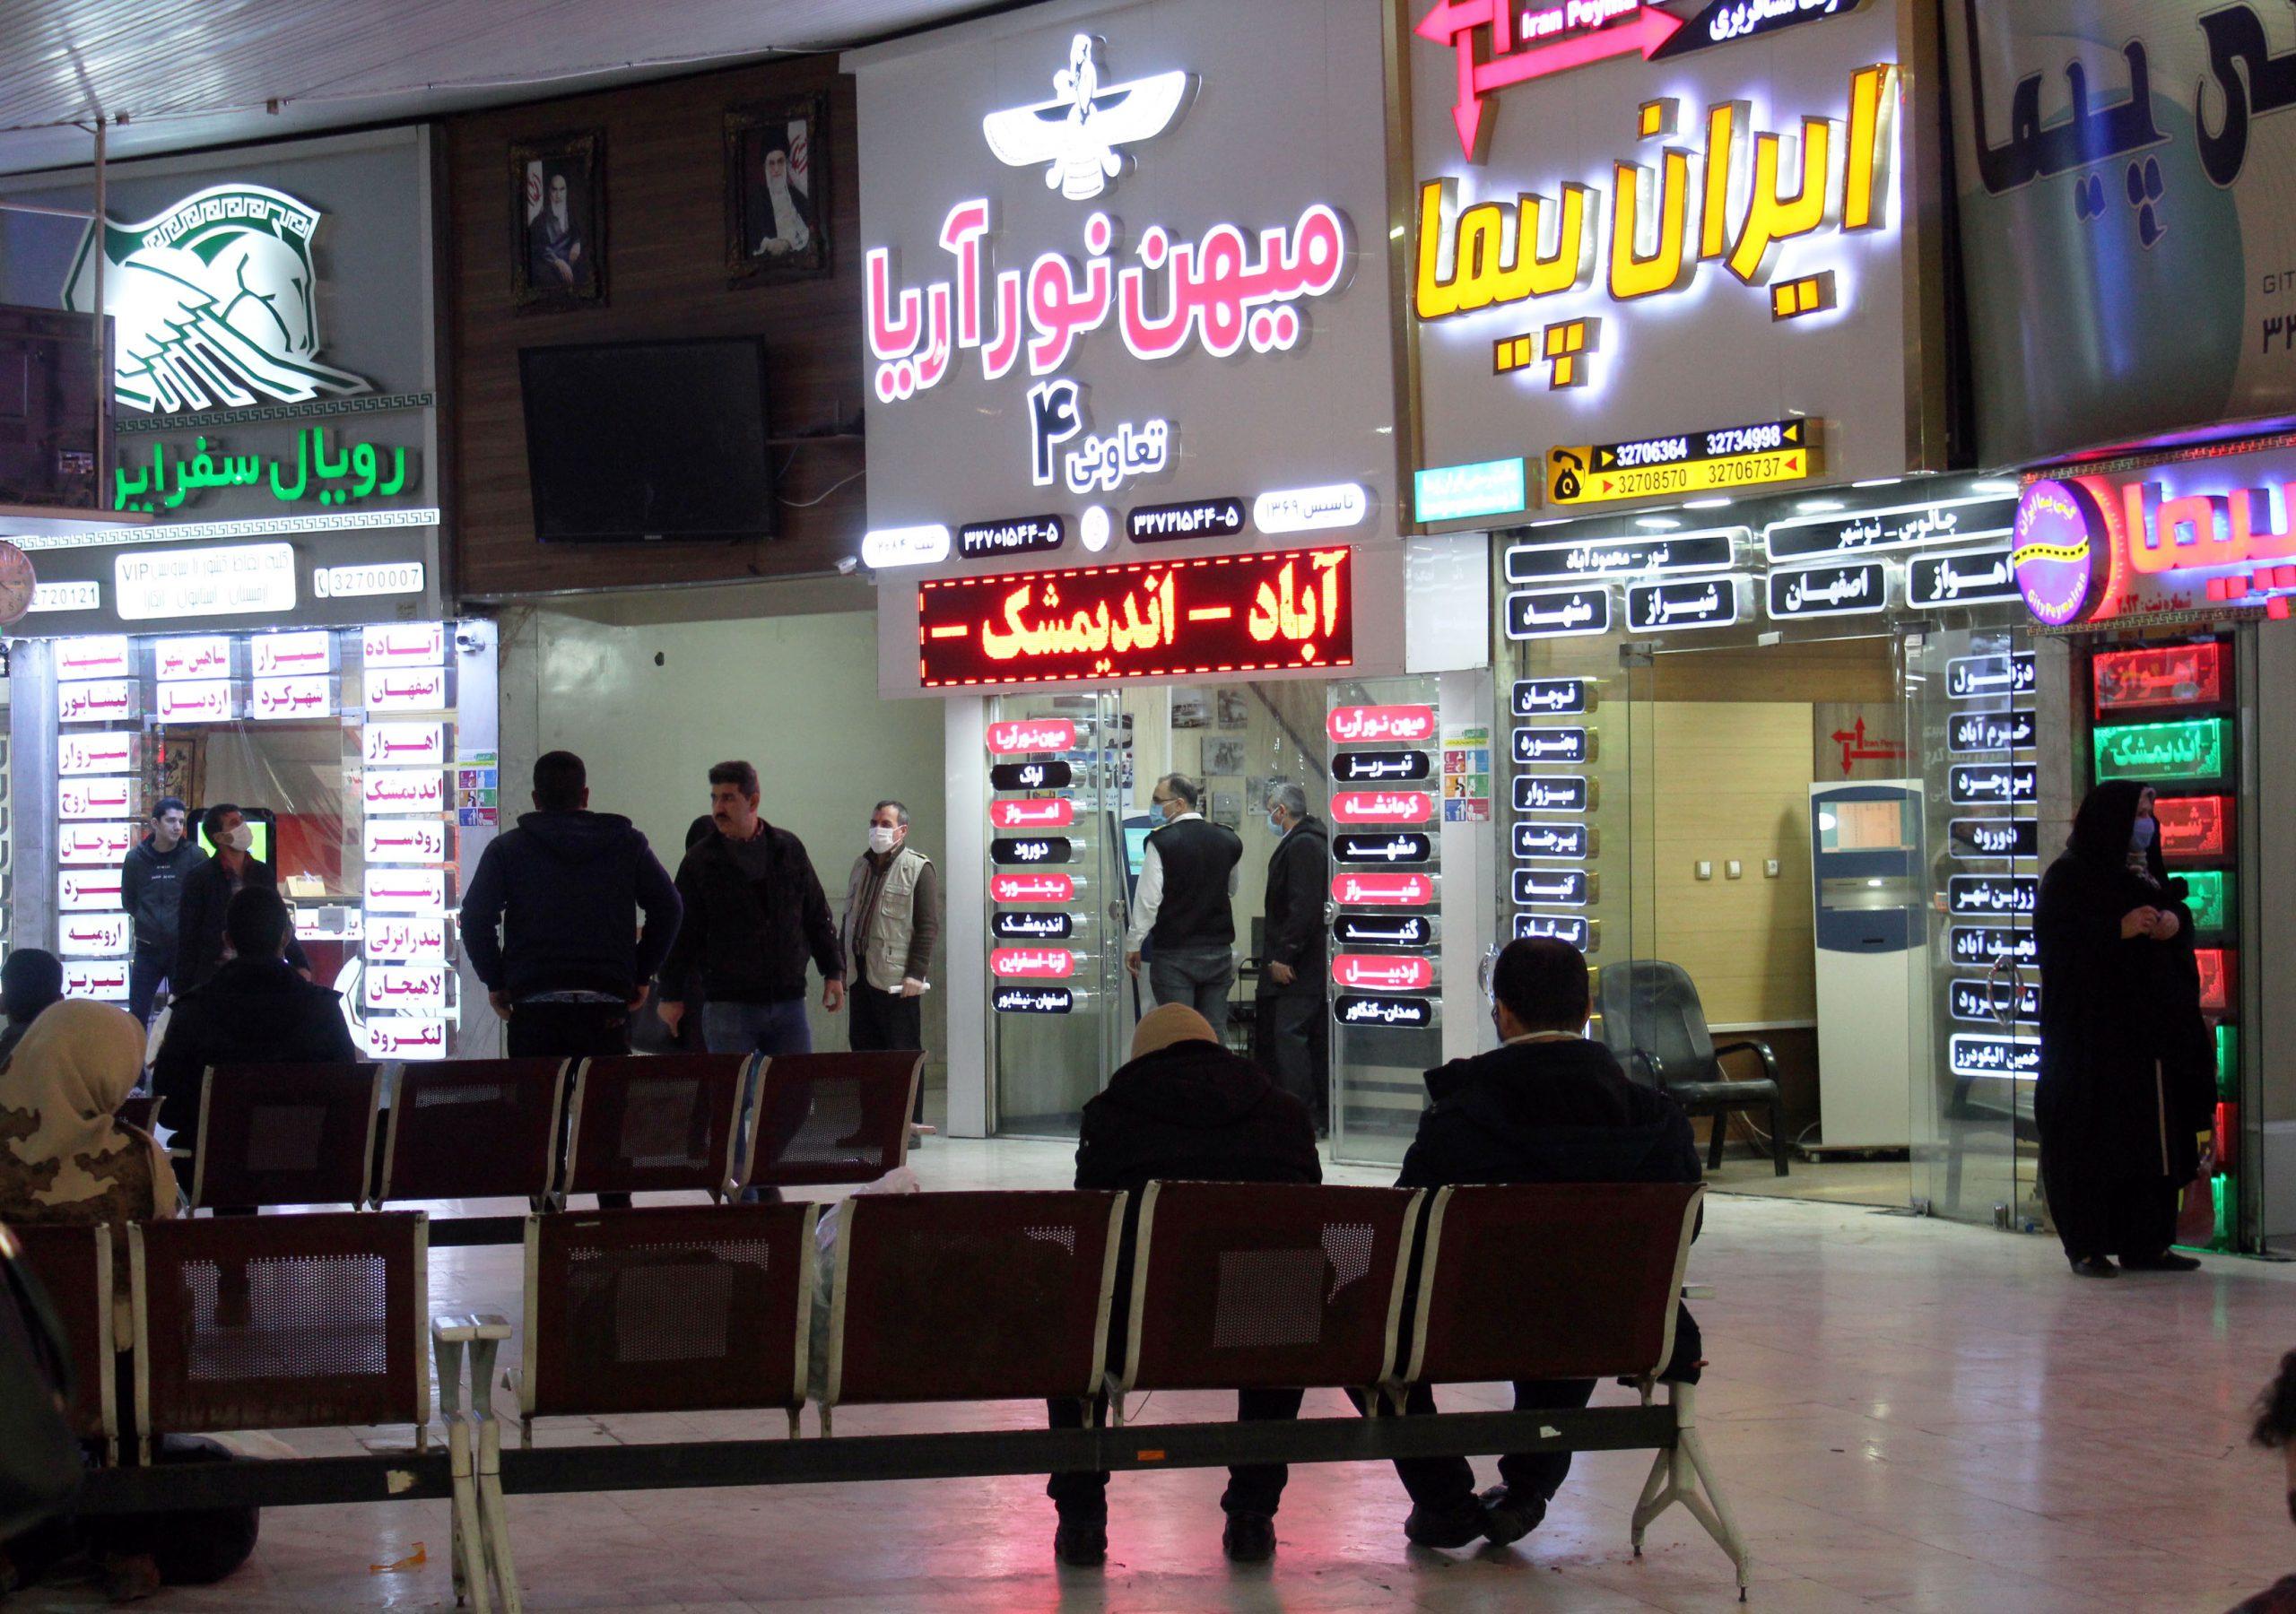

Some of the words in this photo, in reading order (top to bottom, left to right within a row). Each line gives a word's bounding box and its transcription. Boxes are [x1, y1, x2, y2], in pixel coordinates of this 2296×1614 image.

[1522, 12, 1563, 39] Iran
[1608, 65, 1894, 321] ایران
[982, 213, 1113, 379] نور
[1119, 204, 1344, 360] میهن
[1416, 179, 1589, 389] پیما
[865, 198, 988, 404] آریا
[1065, 419, 1168, 494] تعاونی
[1616, 438, 1689, 467] 32706364
[1706, 424, 1782, 456] 32734998
[165, 436, 260, 509] سفر
[270, 426, 405, 507] رویال
[1618, 468, 1688, 495] 32708570
[1708, 457, 1780, 484] 32706737
[1838, 516, 1883, 549] نوشهر
[1898, 508, 1958, 541] چالوس
[1644, 542, 1670, 574] نور
[122, 563, 150, 582] VIP
[334, 568, 419, 591] 32700007
[1929, 553, 2014, 600] اهواز
[1785, 567, 1868, 612] اصفهان
[1247, 549, 1352, 663] آباد
[1523, 594, 1593, 629] مشهد
[1645, 584, 1719, 625] شیراز
[981, 568, 1176, 673] اندیمشک
[258, 638, 326, 671] شیراز
[366, 629, 441, 661] آباده
[371, 676, 439, 704] اصفهان
[1953, 662, 2034, 693] دزفول
[62, 684, 128, 717] نیشابور
[162, 689, 228, 716] اردبیل
[261, 684, 324, 712] شهرکرد
[1390, 716, 1426, 736] میهن
[1958, 716, 1985, 747] آباد
[1987, 716, 2031, 746] خرم
[62, 741, 128, 769] سبزوار
[370, 730, 439, 759] اهواز
[2109, 729, 2202, 772] اندیمشک
[1019, 765, 1044, 787] اراک
[1349, 753, 1413, 777] تبریز
[62, 782, 127, 813] فاروج
[366, 777, 443, 805] اندیمشک
[1524, 781, 1576, 806] سبزوار
[1958, 772, 2034, 797] بروجرد
[1004, 803, 1059, 824] اهواز
[1344, 794, 1419, 820] کرمانشاه
[370, 829, 441, 854] رودسر
[1014, 842, 1049, 861] دورود
[1346, 835, 1417, 861] مشهد
[1973, 826, 2020, 851] دورود
[65, 879, 123, 903] زد
[370, 875, 441, 905] رشت
[998, 878, 1065, 898] بجنورد
[1344, 876, 1421, 903] شیراز
[1524, 874, 1576, 900] گنبد
[1956, 881, 1991, 909] شهر
[68, 921, 122, 947] ارومیه
[1000, 914, 1064, 938] اندیمشک
[1345, 918, 1420, 945] گنبد
[1957, 930, 1986, 961] آباد
[1986, 933, 2037, 961] نجف
[66, 966, 125, 994] تبریز
[1345, 959, 1420, 985] اردبیل
[370, 973, 441, 1001] لاهیجان
[1958, 989, 2037, 1015] شارود
[370, 1023, 442, 1053] لنگرود
